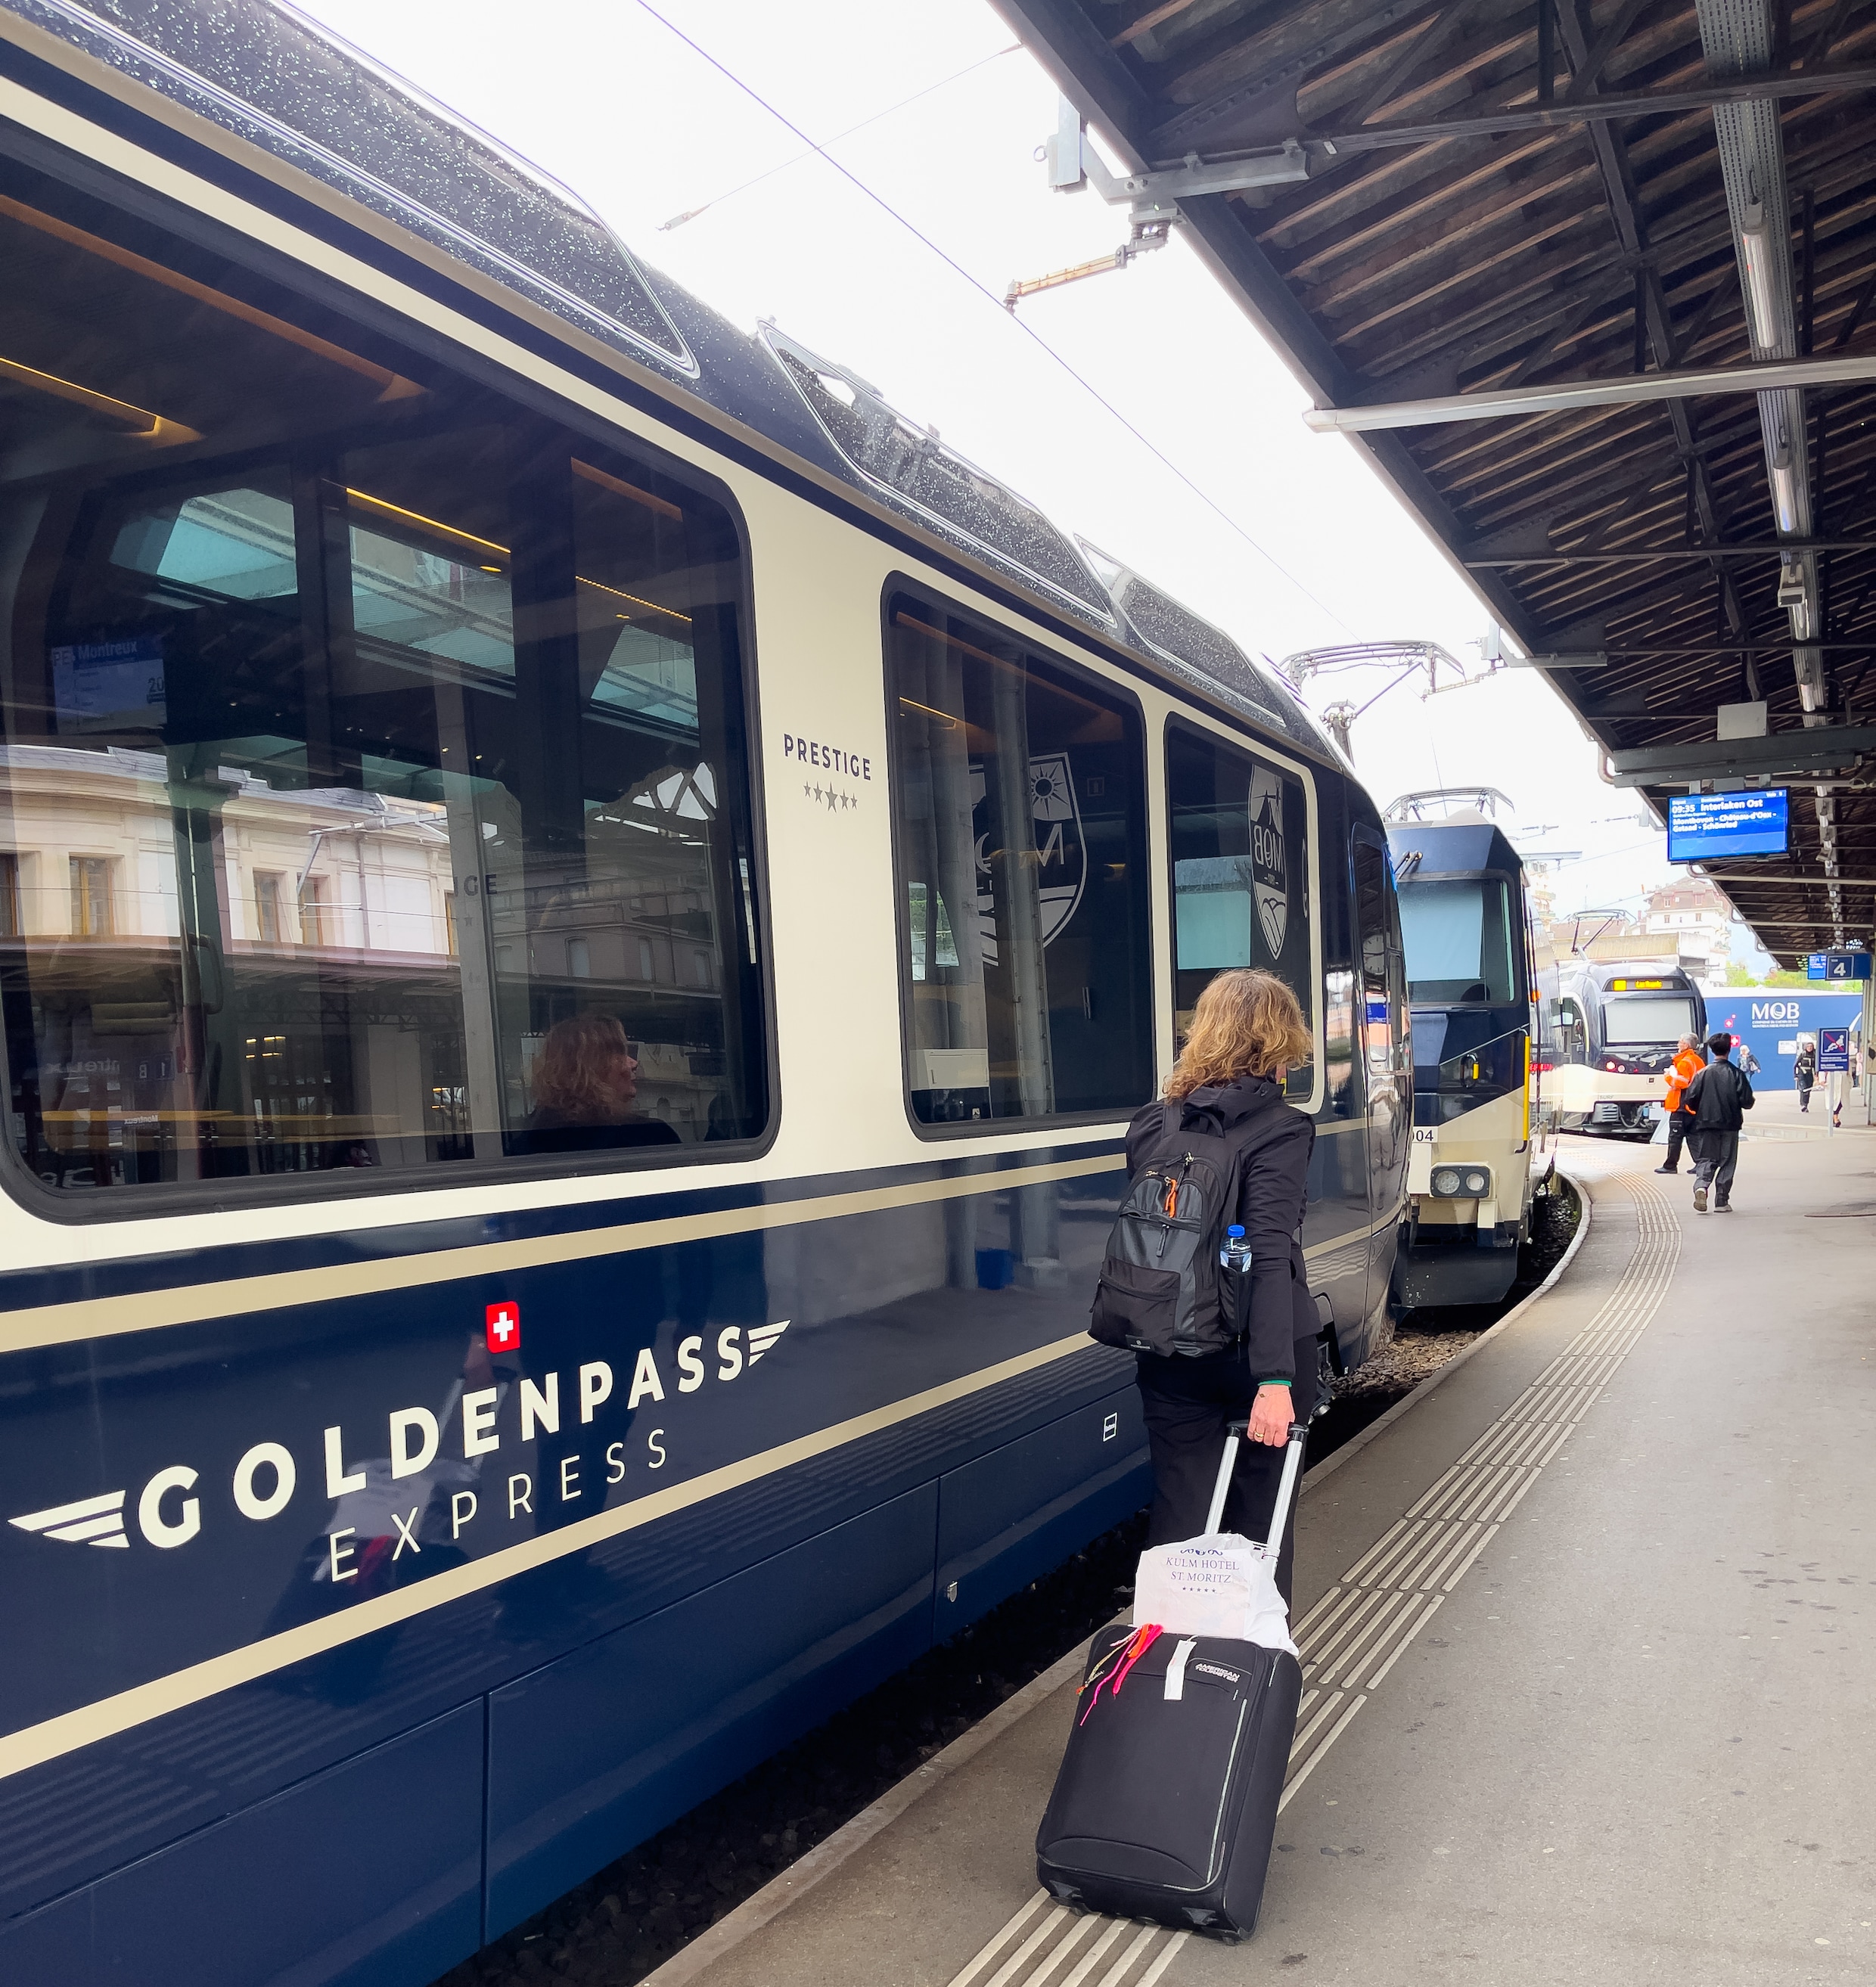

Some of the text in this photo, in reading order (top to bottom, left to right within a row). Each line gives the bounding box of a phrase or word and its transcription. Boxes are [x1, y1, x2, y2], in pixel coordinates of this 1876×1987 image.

[78, 640, 138, 660] Montreux
[784, 733, 871, 781] PRESTIGE
[1672, 799, 1763, 814] 09:35 Interlaken Ost
[1834, 962, 1846, 976] 4
[1751, 1001, 1800, 1020] MOB
[1412, 1130, 1433, 1141] 04
[138, 1325, 743, 1548] GOLDENPASS
[329, 1429, 666, 1582] EXPRESS
[1166, 1557, 1240, 1570] KULM HOTEL
[1187, 1573, 1232, 1583] MORITZ
[1195, 1663, 1241, 1679] AMERICAN
